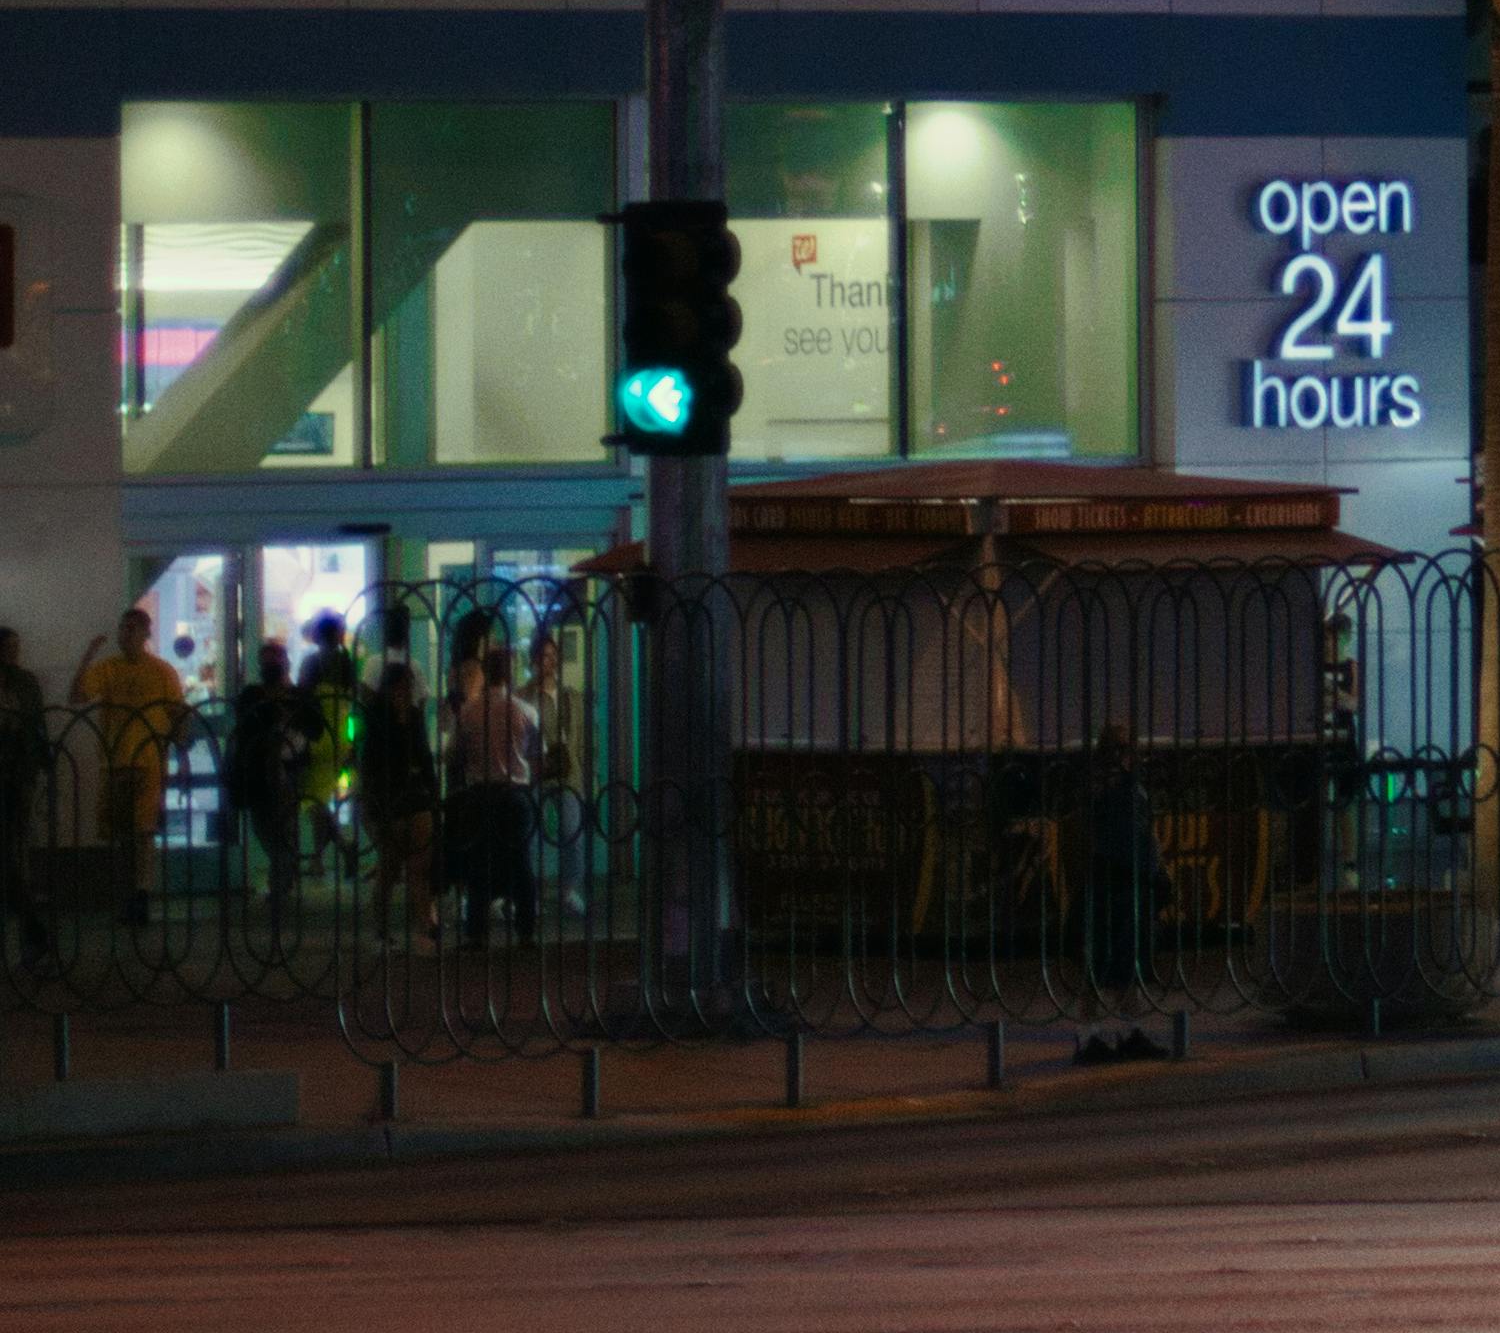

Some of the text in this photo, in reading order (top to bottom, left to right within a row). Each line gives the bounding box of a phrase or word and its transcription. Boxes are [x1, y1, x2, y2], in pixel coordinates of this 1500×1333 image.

[1258, 174, 1414, 250] open
[809, 273, 890, 309] Than
[1278, 252, 1395, 359] 24
[783, 326, 889, 361] see you
[1250, 359, 1422, 432] hours
[1035, 505, 1073, 530] SHOW
[1077, 504, 1127, 529] TICKETS
